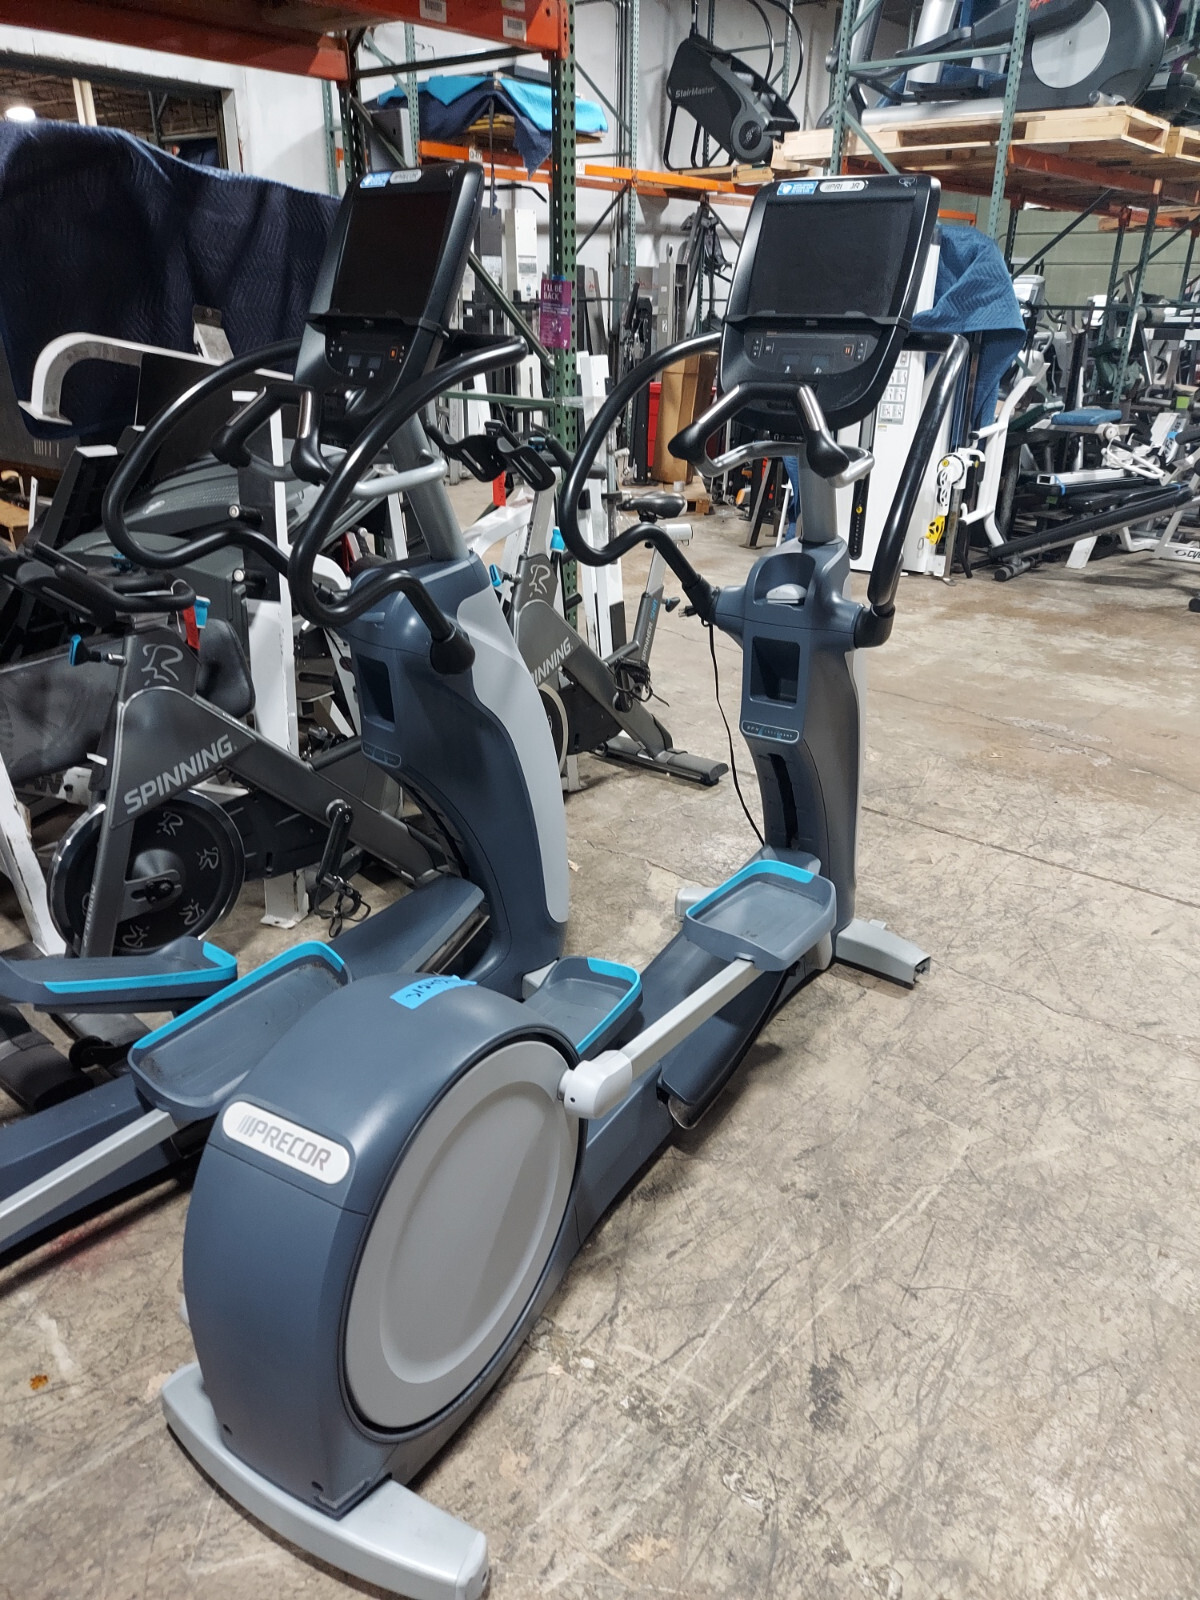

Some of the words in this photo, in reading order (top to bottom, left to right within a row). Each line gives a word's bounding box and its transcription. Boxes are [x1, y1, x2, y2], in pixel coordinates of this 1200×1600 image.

[543, 291, 559, 300] BACK
[531, 636, 570, 686] INNING
[123, 734, 233, 814] SPINNING
[247, 1118, 332, 1171] PRECOR
